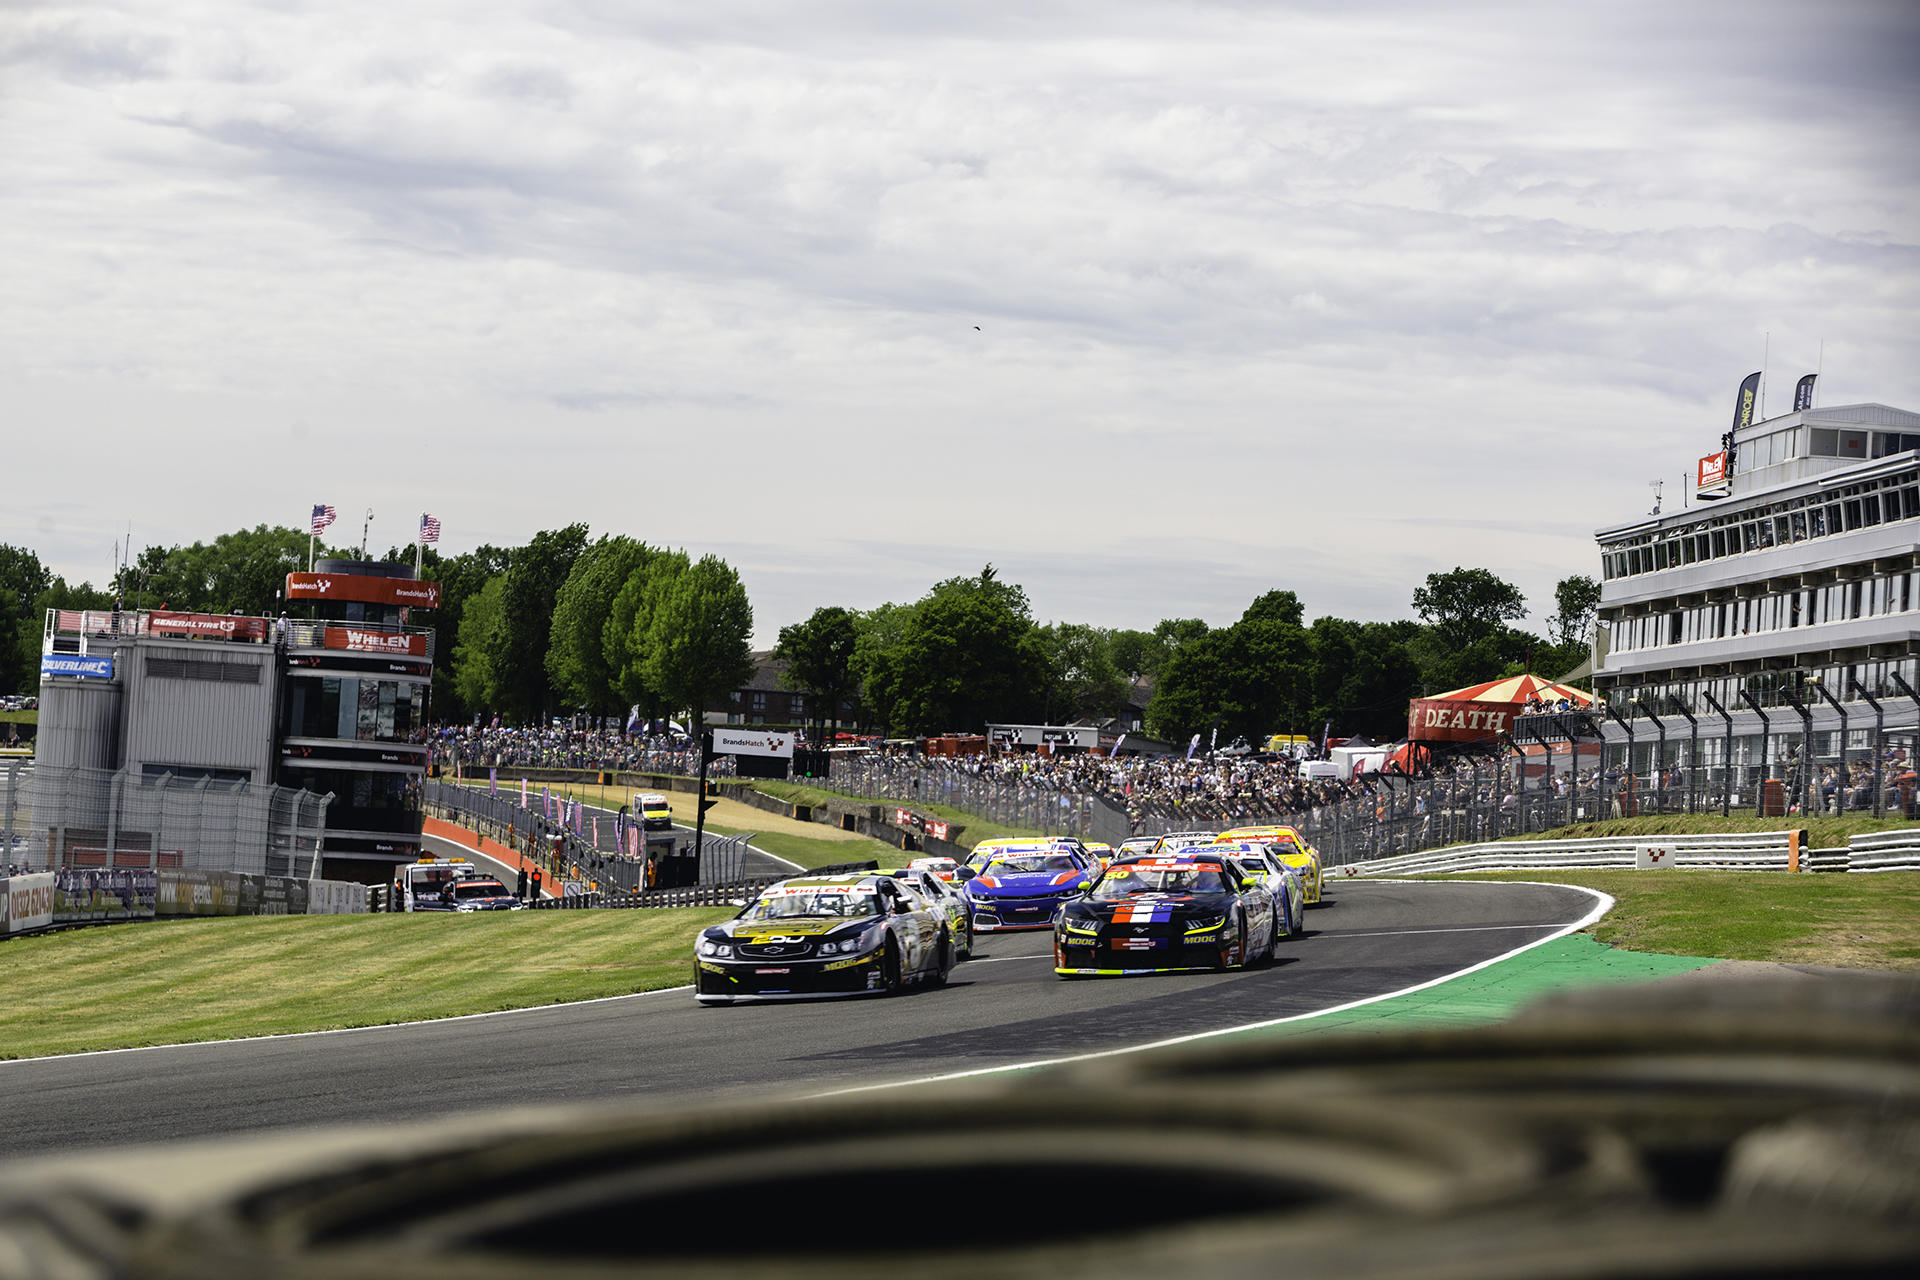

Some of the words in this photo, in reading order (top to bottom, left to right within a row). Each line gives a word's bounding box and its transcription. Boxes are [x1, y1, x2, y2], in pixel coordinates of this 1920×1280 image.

[396, 588, 429, 598] BrandsHatch
[153, 618, 196, 628] GENERAL
[197, 621, 220, 629] TIRE
[346, 630, 410, 648] WHELEN
[45, 659, 100, 672] SILVERLINE
[1425, 708, 1508, 730] DEATH
[722, 738, 764, 747] BrandsHatch
[1130, 864, 1198, 872] WHELEN
[1104, 871, 1130, 880] 50
[785, 886, 851, 895] WHELEN
[11, 889, 30, 921] 01322
[31, 885, 53, 917] 621430
[1067, 937, 1096, 946] MOOG
[1184, 935, 1216, 945] MOOG
[700, 961, 725, 974] MOOG
[824, 958, 857, 971] MOOG
